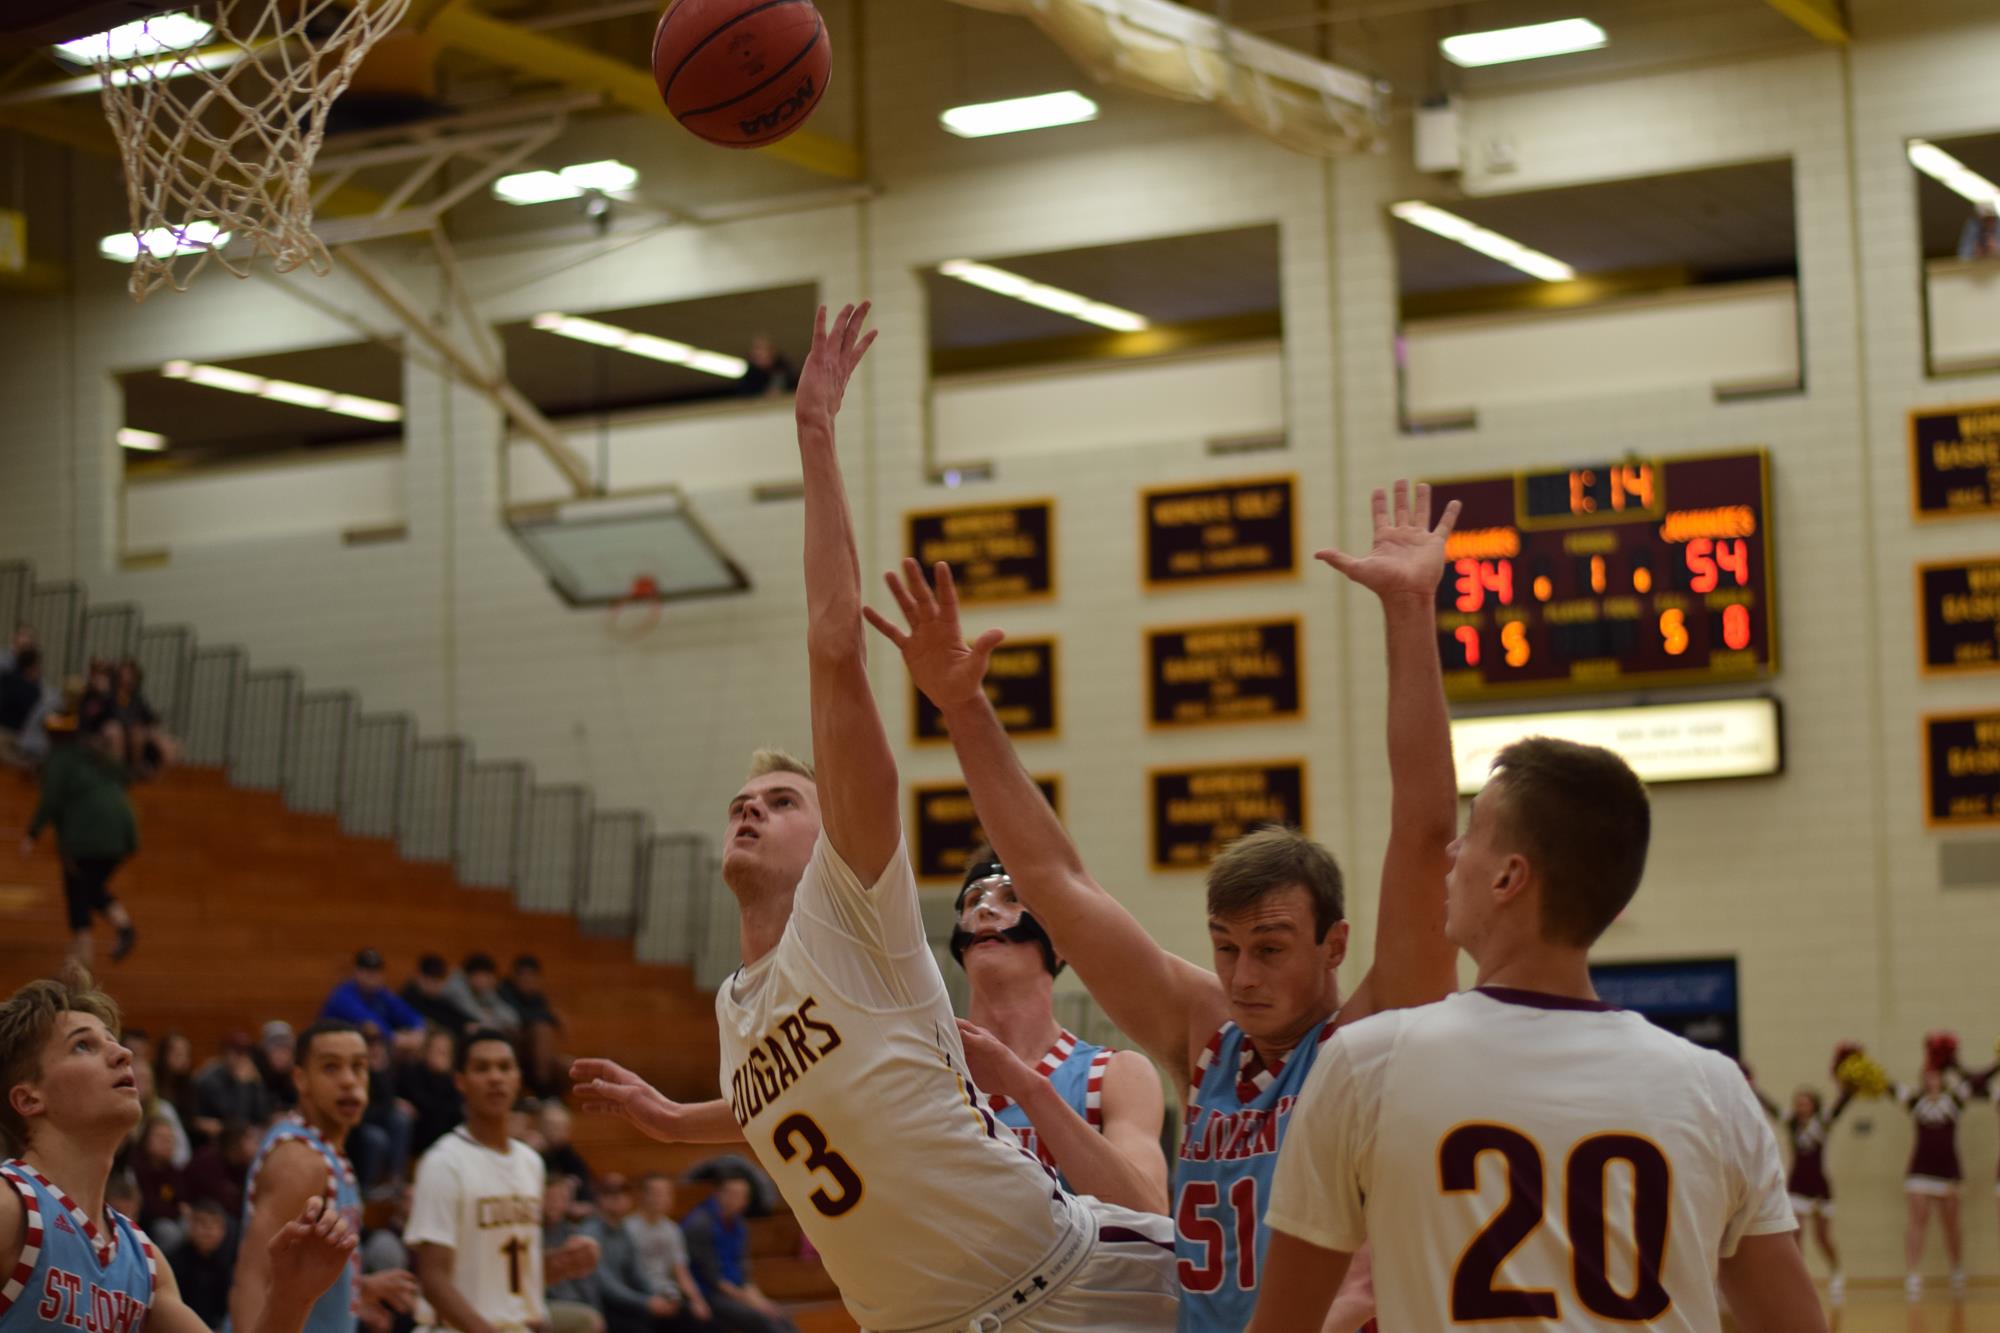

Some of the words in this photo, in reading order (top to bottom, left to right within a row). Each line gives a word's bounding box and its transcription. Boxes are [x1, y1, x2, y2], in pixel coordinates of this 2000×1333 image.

[739, 73, 814, 137] NCAA
[1568, 463, 1654, 514] 1:14
[1455, 558, 1513, 613] 34
[1686, 537, 1748, 593] 54
[731, 995, 842, 1129] OUGARS
[771, 1110, 866, 1219] 3
[1176, 1177, 1257, 1294] 51
[1435, 1120, 1674, 1324] 20
